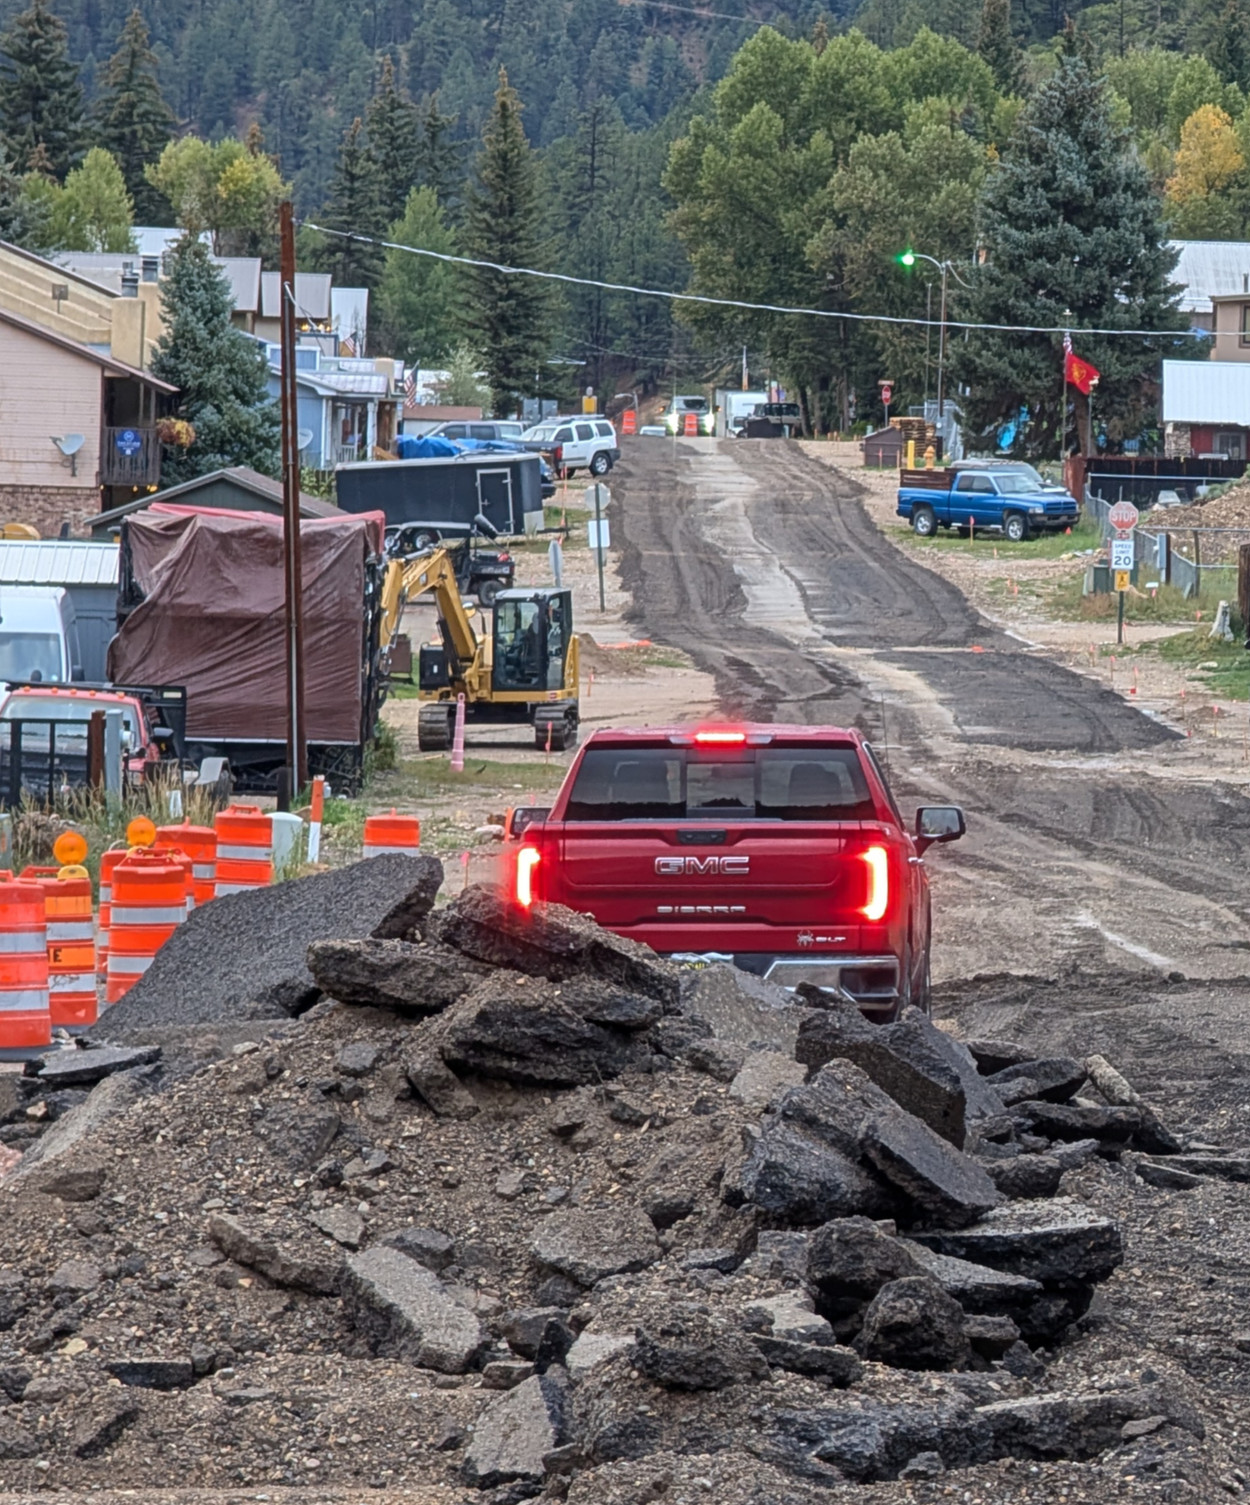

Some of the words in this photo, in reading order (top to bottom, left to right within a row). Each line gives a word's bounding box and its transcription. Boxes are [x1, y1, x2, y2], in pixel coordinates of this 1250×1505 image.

[1111, 510, 1136, 522] STOP
[1114, 555, 1132, 566] 20
[654, 856, 750, 875] GMC
[657, 905, 746, 914] SIERRA
